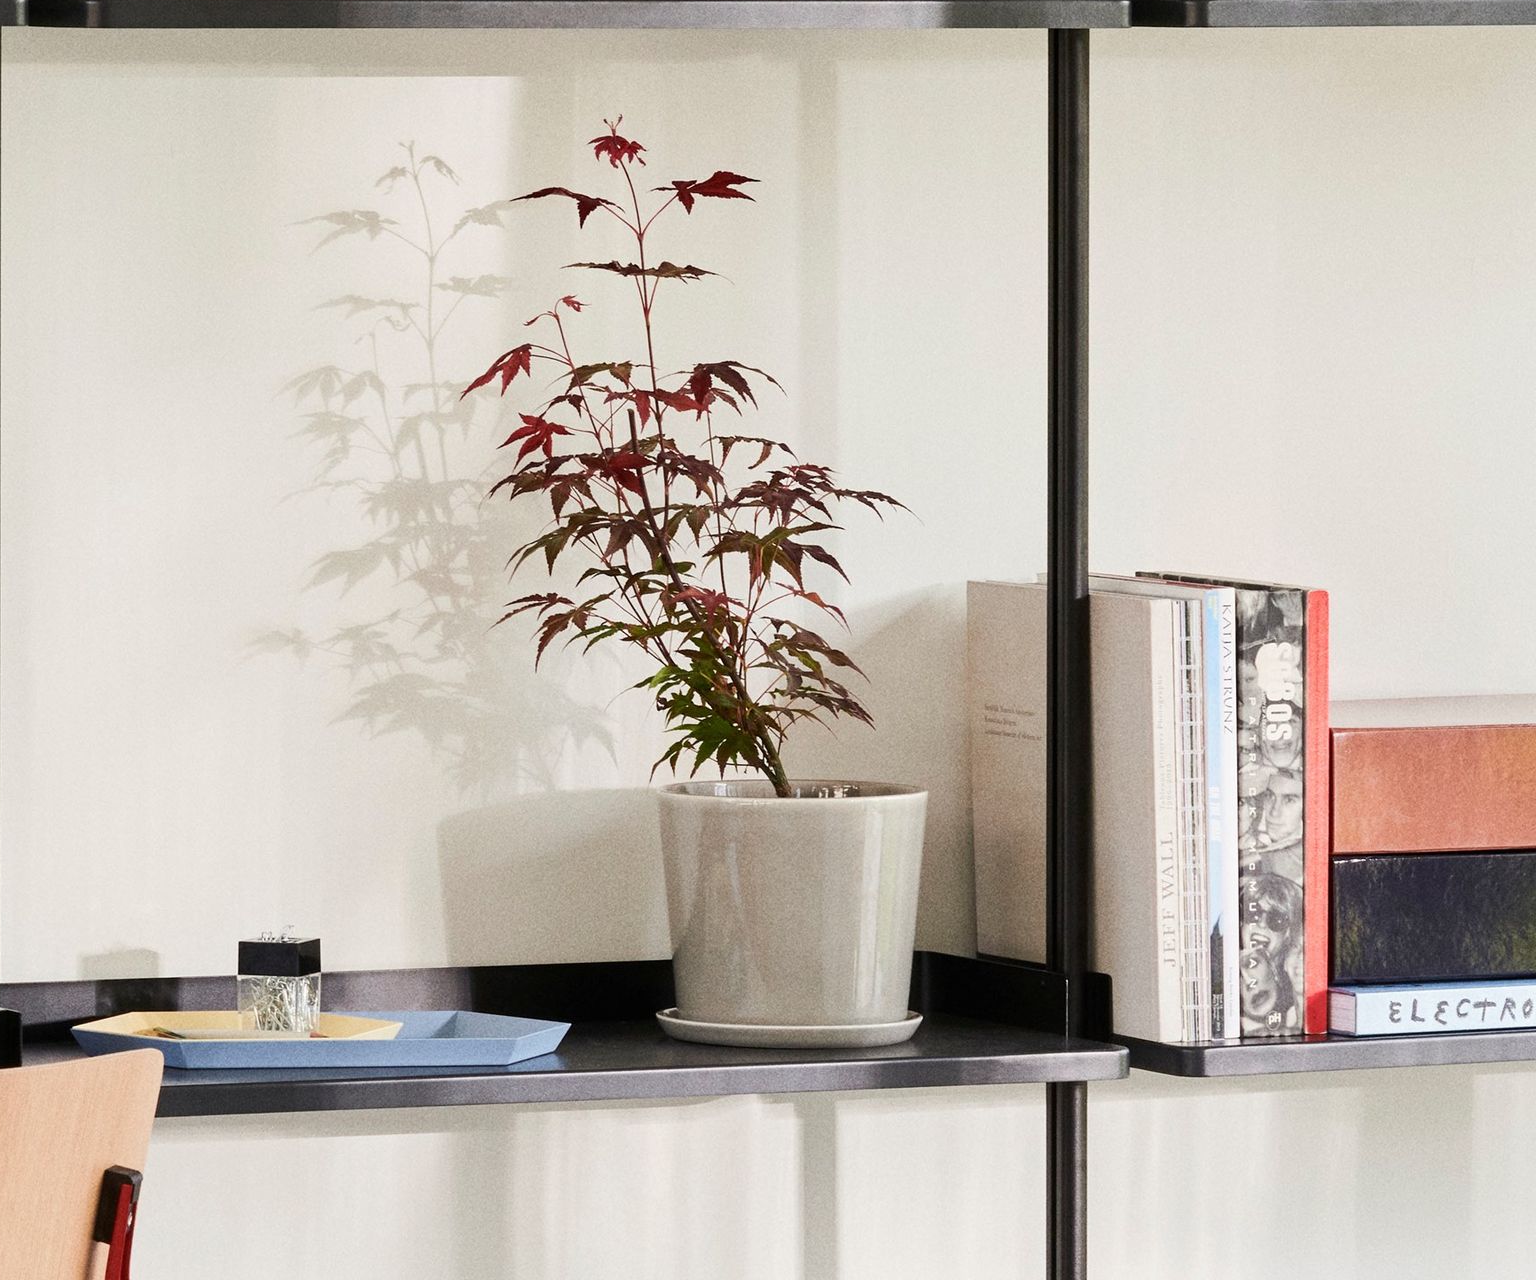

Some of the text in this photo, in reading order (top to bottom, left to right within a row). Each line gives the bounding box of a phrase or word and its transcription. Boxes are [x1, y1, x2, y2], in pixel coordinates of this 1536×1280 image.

[1222, 665, 1234, 736] STRUNZ
[1248, 696, 1258, 818] PATRICK
[1160, 831, 1176, 968] JEFF WALL
[1268, 1012, 1282, 1026] pH
[1388, 997, 1534, 1026] ELECTRO
